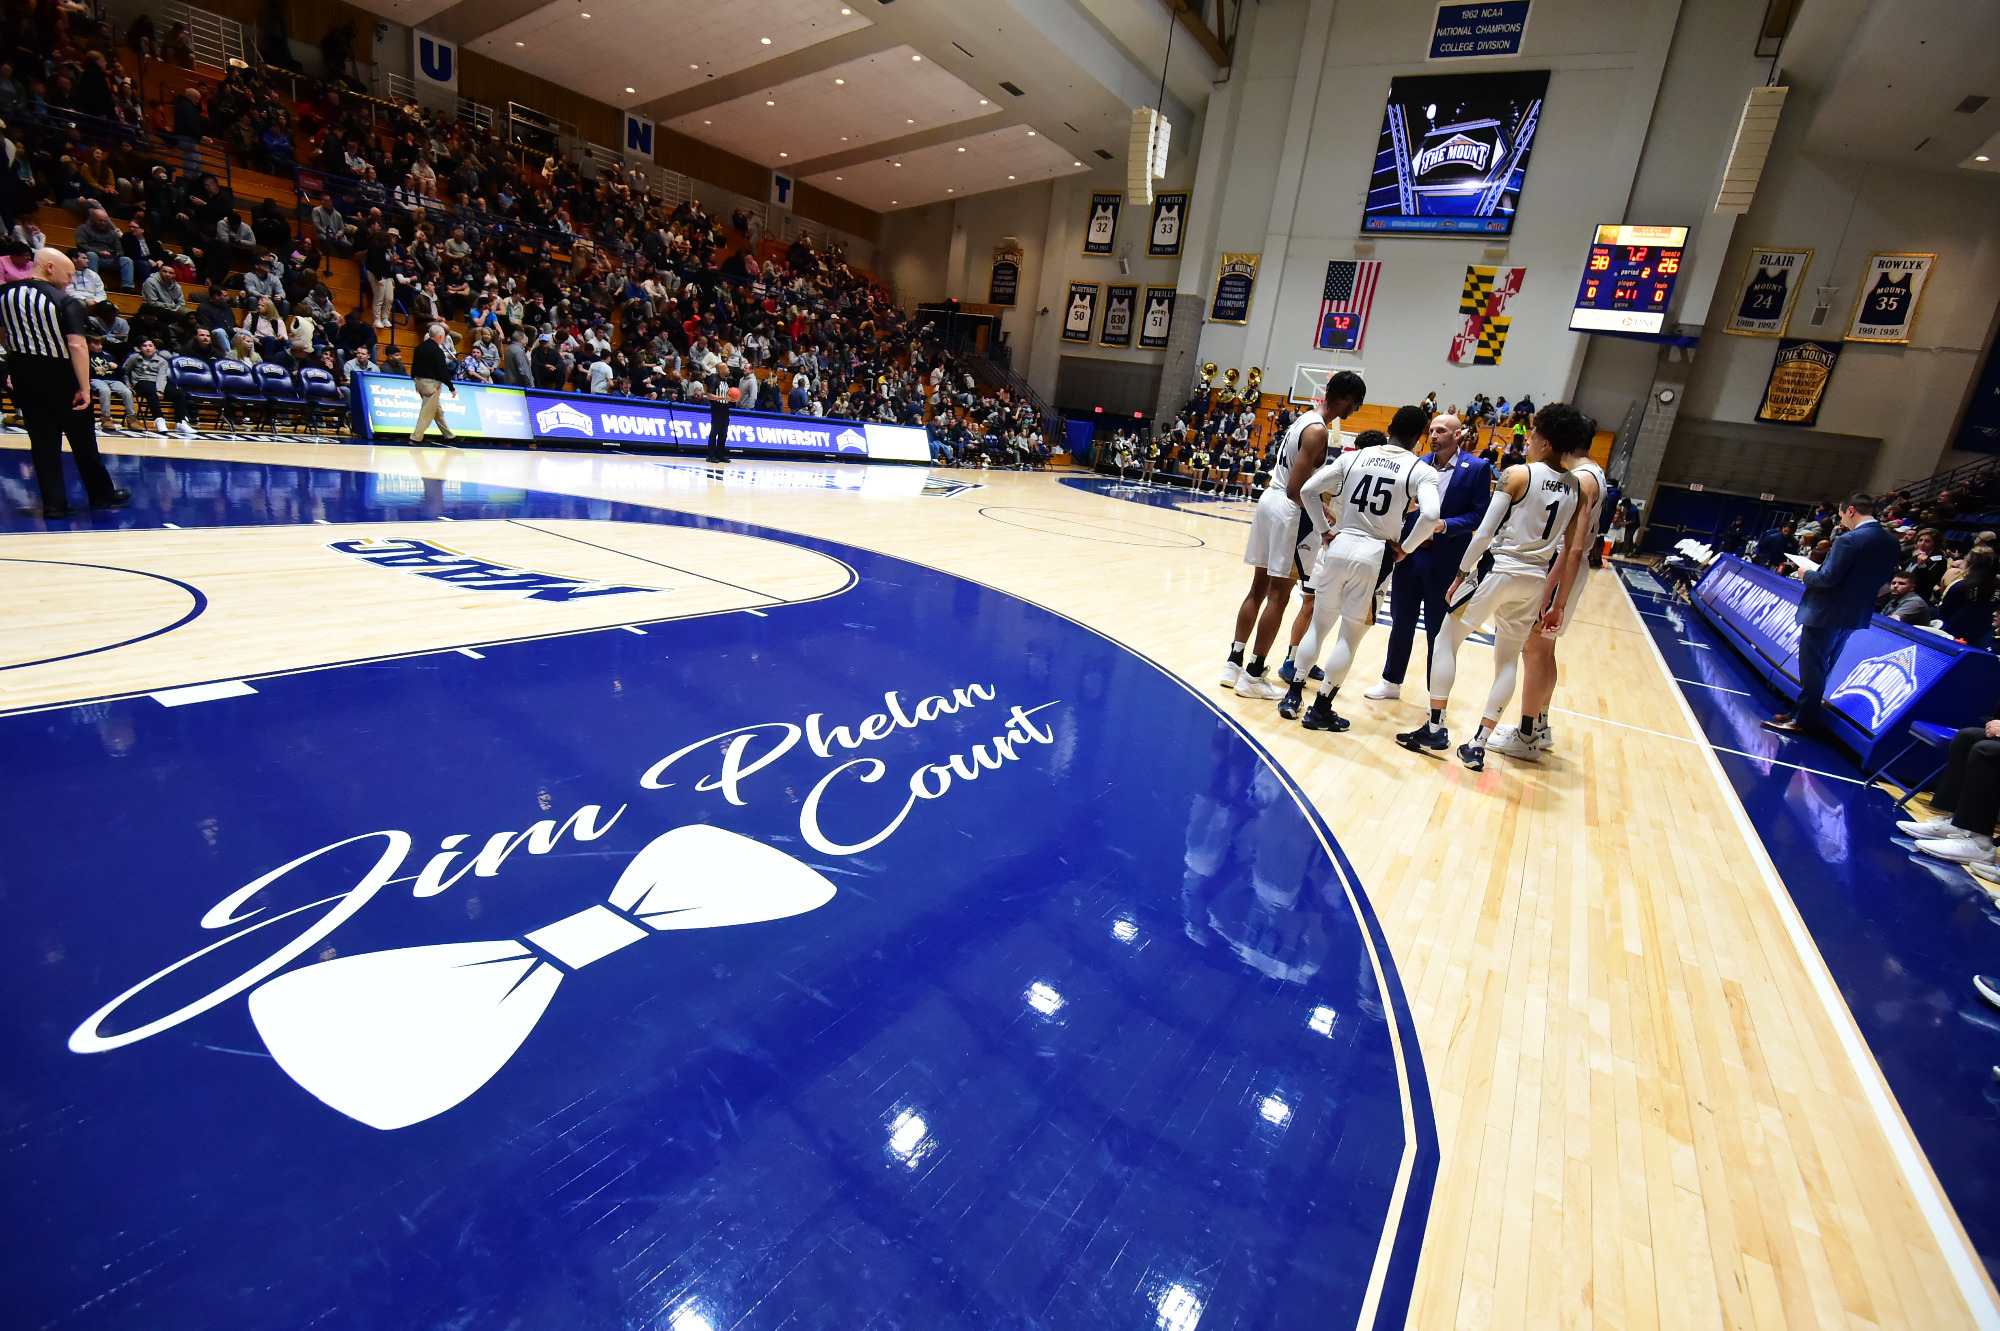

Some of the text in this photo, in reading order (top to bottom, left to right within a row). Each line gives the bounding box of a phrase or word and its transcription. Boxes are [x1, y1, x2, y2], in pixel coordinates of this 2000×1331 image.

[1461, 8, 1503, 20] 1962 NCAA
[1437, 23, 1522, 37] NATIONAL CHAMPIONS
[1440, 40, 1511, 52] COLLEGE DIVISION
[419, 36, 791, 204] U N T
[1424, 144, 1489, 170] THE MOUNT
[1159, 196, 1183, 204] CARTER
[1096, 222, 1108, 233] 32
[1160, 223, 1173, 234] 33
[1626, 246, 1648, 261] 7.2
[1590, 255, 1610, 271] 38
[1657, 258, 1679, 273] 26
[1759, 254, 1795, 267] BLAIR
[1877, 259, 1925, 270] ROWLYK
[1222, 263, 1255, 277] THE MOUNT
[1620, 267, 1651, 279] period 2
[1112, 288, 1132, 296] PHELAN
[1149, 290, 1175, 298] O'REILLY
[1586, 286, 1597, 299] 0
[1753, 283, 1783, 293] MOUNT
[1876, 286, 1907, 296] MOUNT
[1653, 290, 1664, 302] 0
[1752, 294, 1773, 309] 24
[1217, 300, 1246, 308] CHAMPIONS
[1875, 296, 1900, 311] 35
[1074, 311, 1085, 321] 50
[1110, 314, 1126, 325] 830
[1152, 316, 1163, 327] 51
[1333, 316, 1351, 330] 7.2
[1858, 326, 1900, 336] 1991-1995
[1779, 348, 1835, 368] THE MOUNT
[1769, 393, 1817, 406] CHAMPIONS
[1774, 407, 1806, 417] 2022
[601, 414, 667, 437] MOUNT
[668, 420, 698, 440] ST.
[756, 426, 830, 447] UNIVERSITY
[1361, 457, 1401, 474] LIPSCOMB
[1350, 473, 1396, 517] 45
[1541, 499, 1560, 541] 1
[1843, 661, 1915, 719] THE MOUNT
[799, 699, 1061, 857] Court
[67, 682, 996, 1054] Jim Phelan
